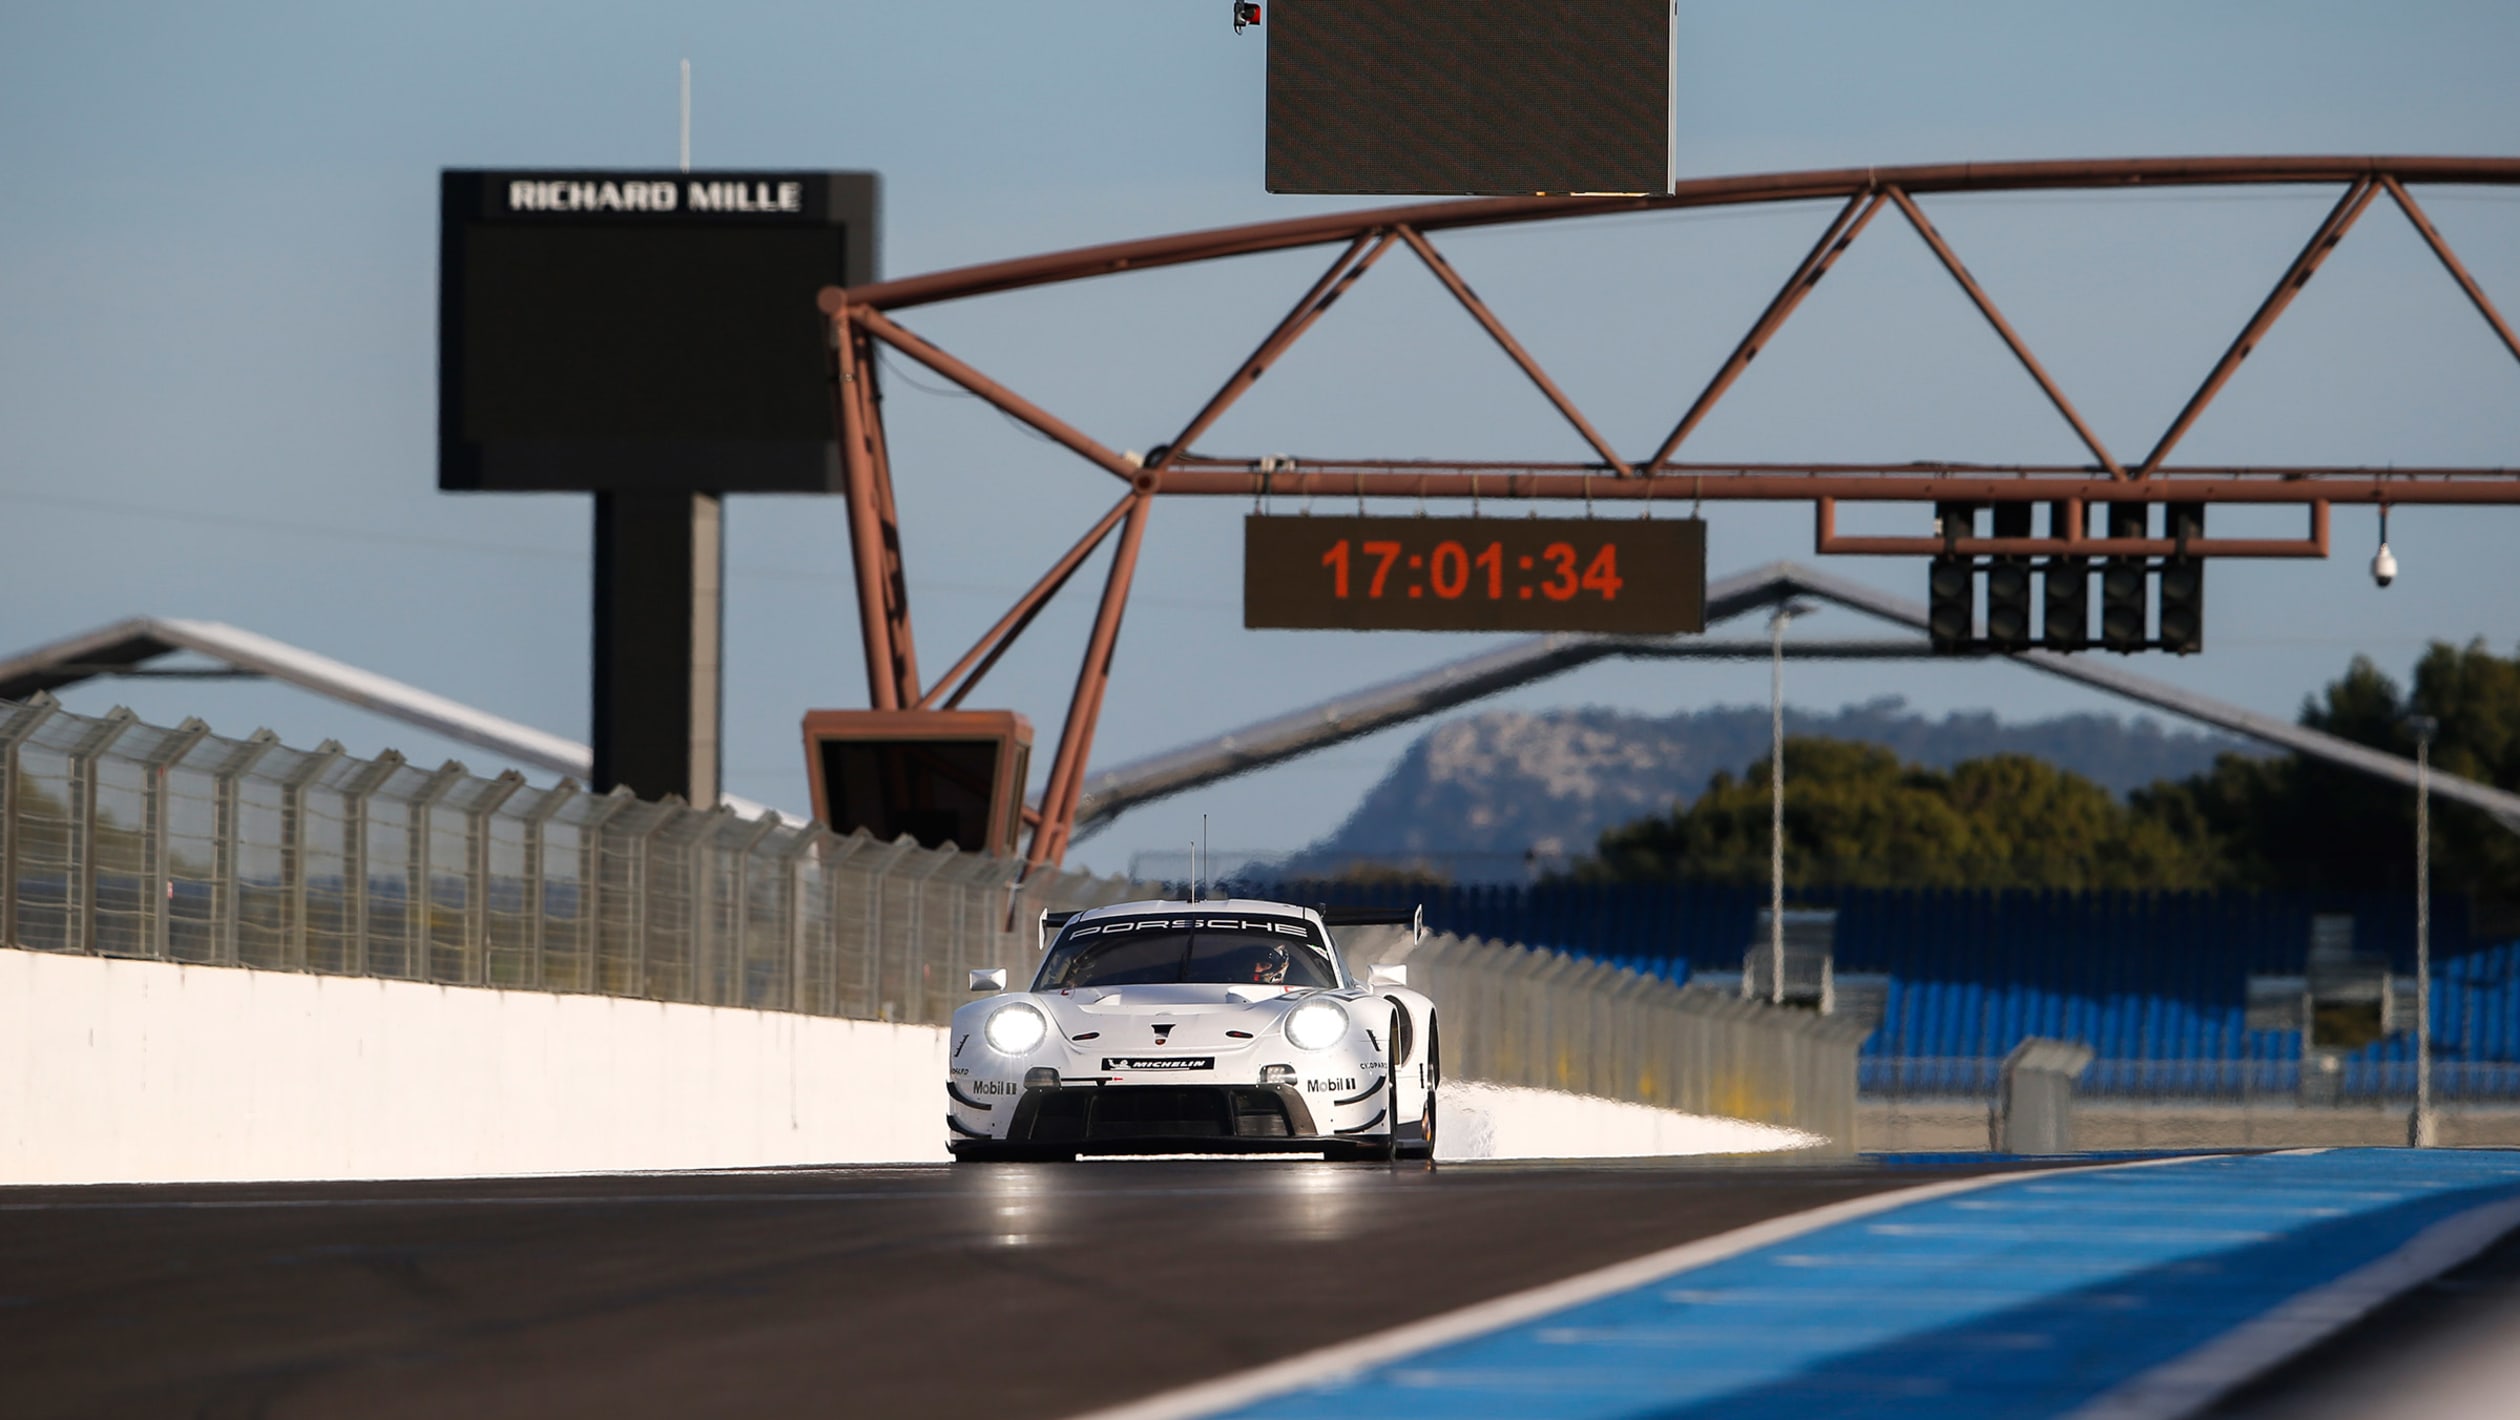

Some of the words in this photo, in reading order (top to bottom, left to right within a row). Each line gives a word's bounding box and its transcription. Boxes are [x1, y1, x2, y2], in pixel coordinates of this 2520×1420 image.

[510, 180, 677, 212] RICHARD
[688, 181, 802, 213] MILLE
[1321, 539, 1624, 601] 17:01:34
[1069, 919, 1308, 940] PORSCHE
[1132, 1060, 1206, 1068] MICHELIN
[973, 1080, 1004, 1095] Mobil
[1307, 1078, 1344, 1093] Mobil
